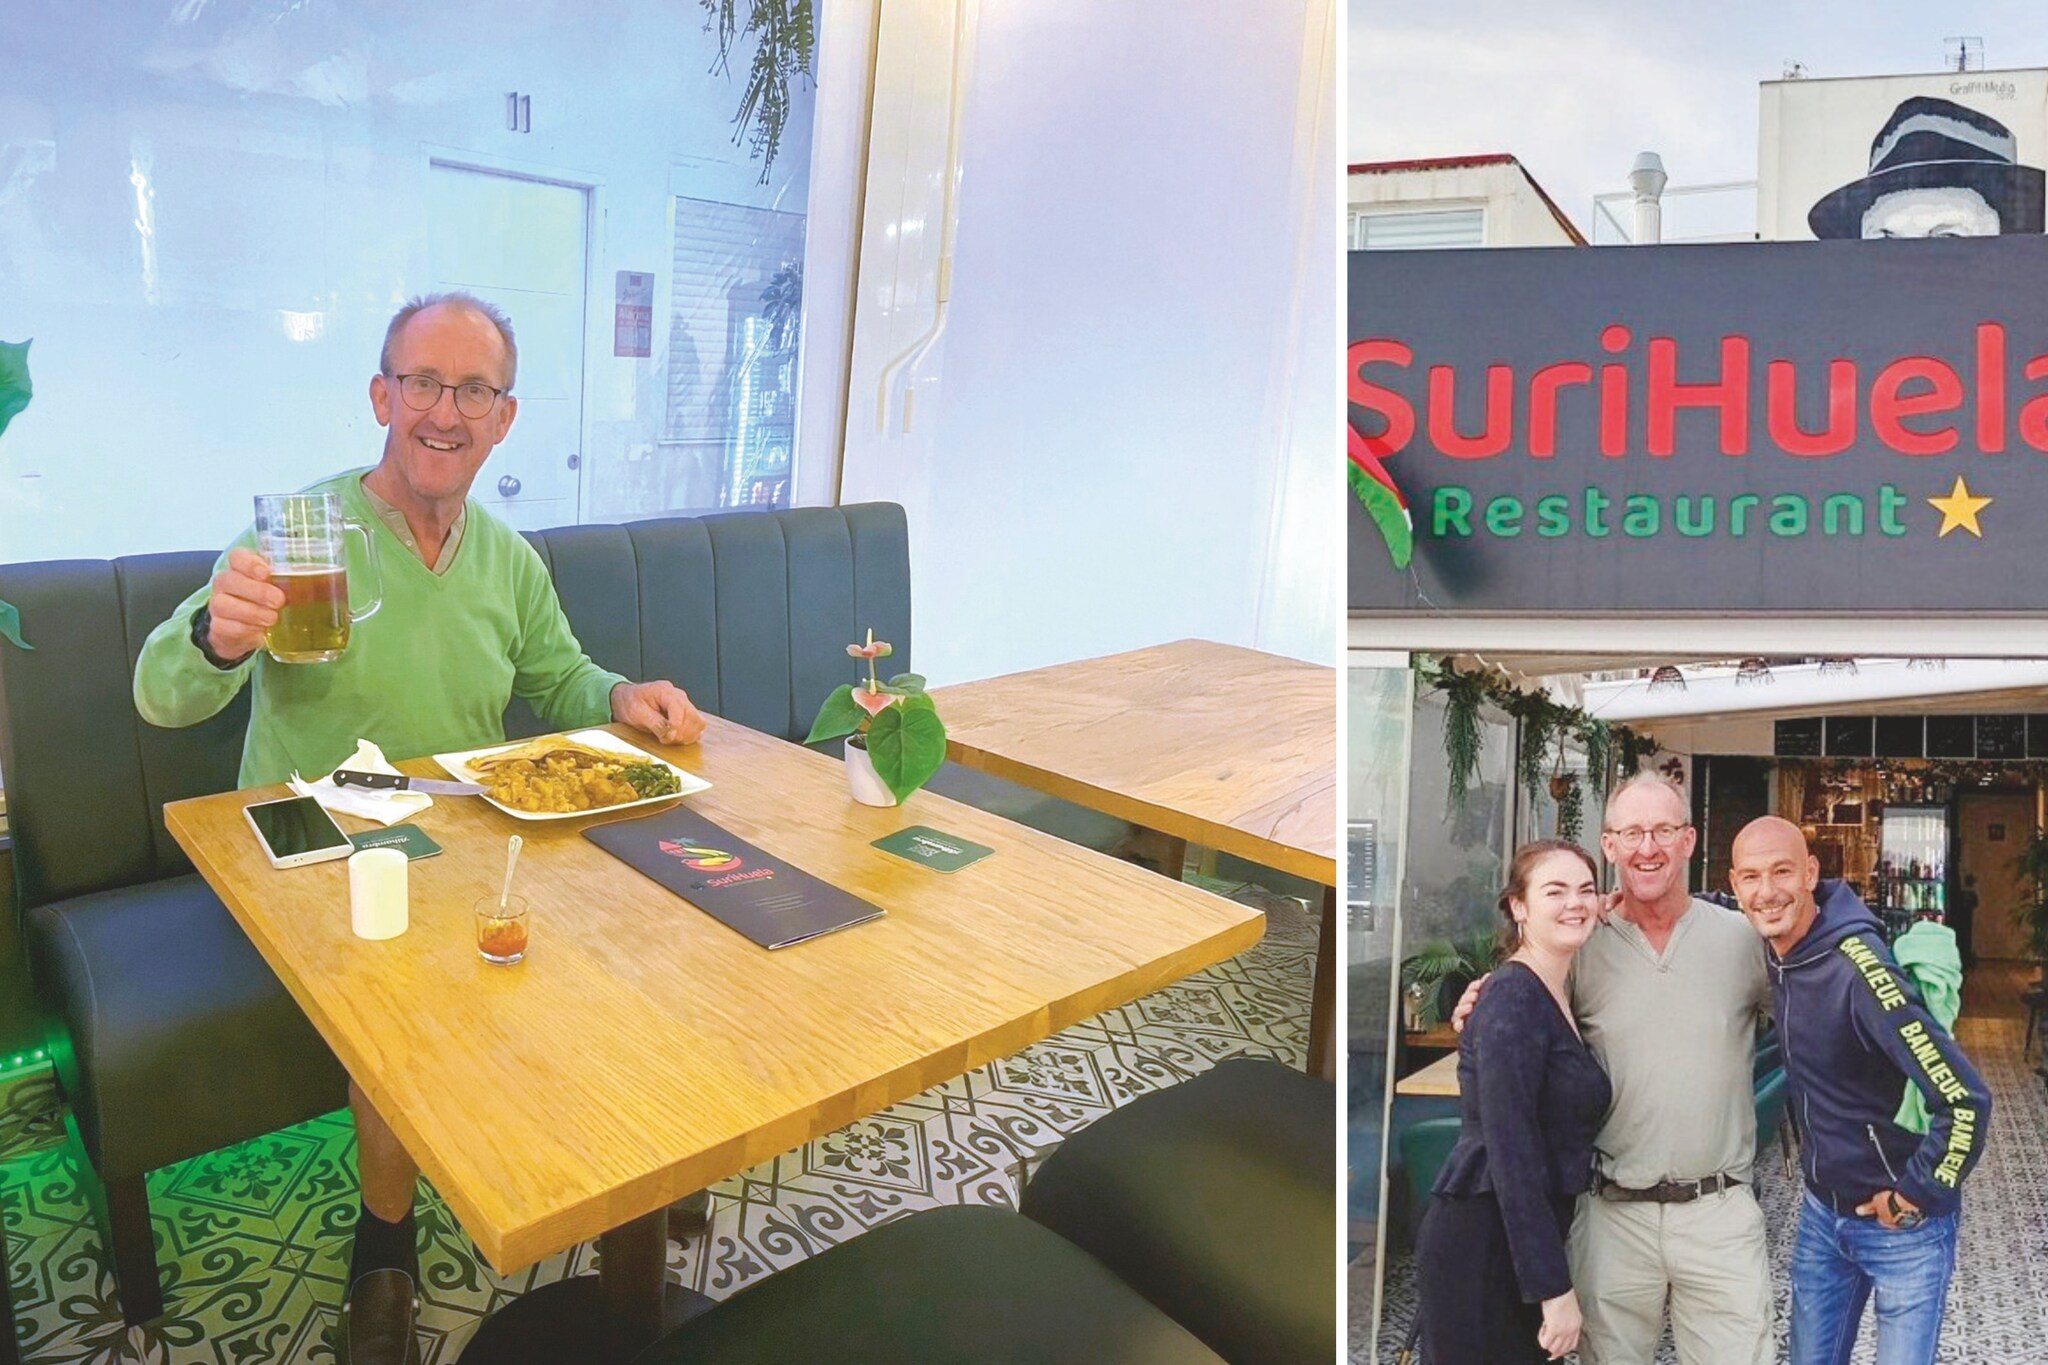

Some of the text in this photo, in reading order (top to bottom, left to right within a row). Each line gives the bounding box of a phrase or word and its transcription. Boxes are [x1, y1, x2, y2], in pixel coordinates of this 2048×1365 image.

[1432, 484, 1909, 538] Restaurant
[706, 867, 775, 888] SuriHuela
[1839, 936, 1976, 1189] BANLIEUE BANLIEUE BANLIEUE
